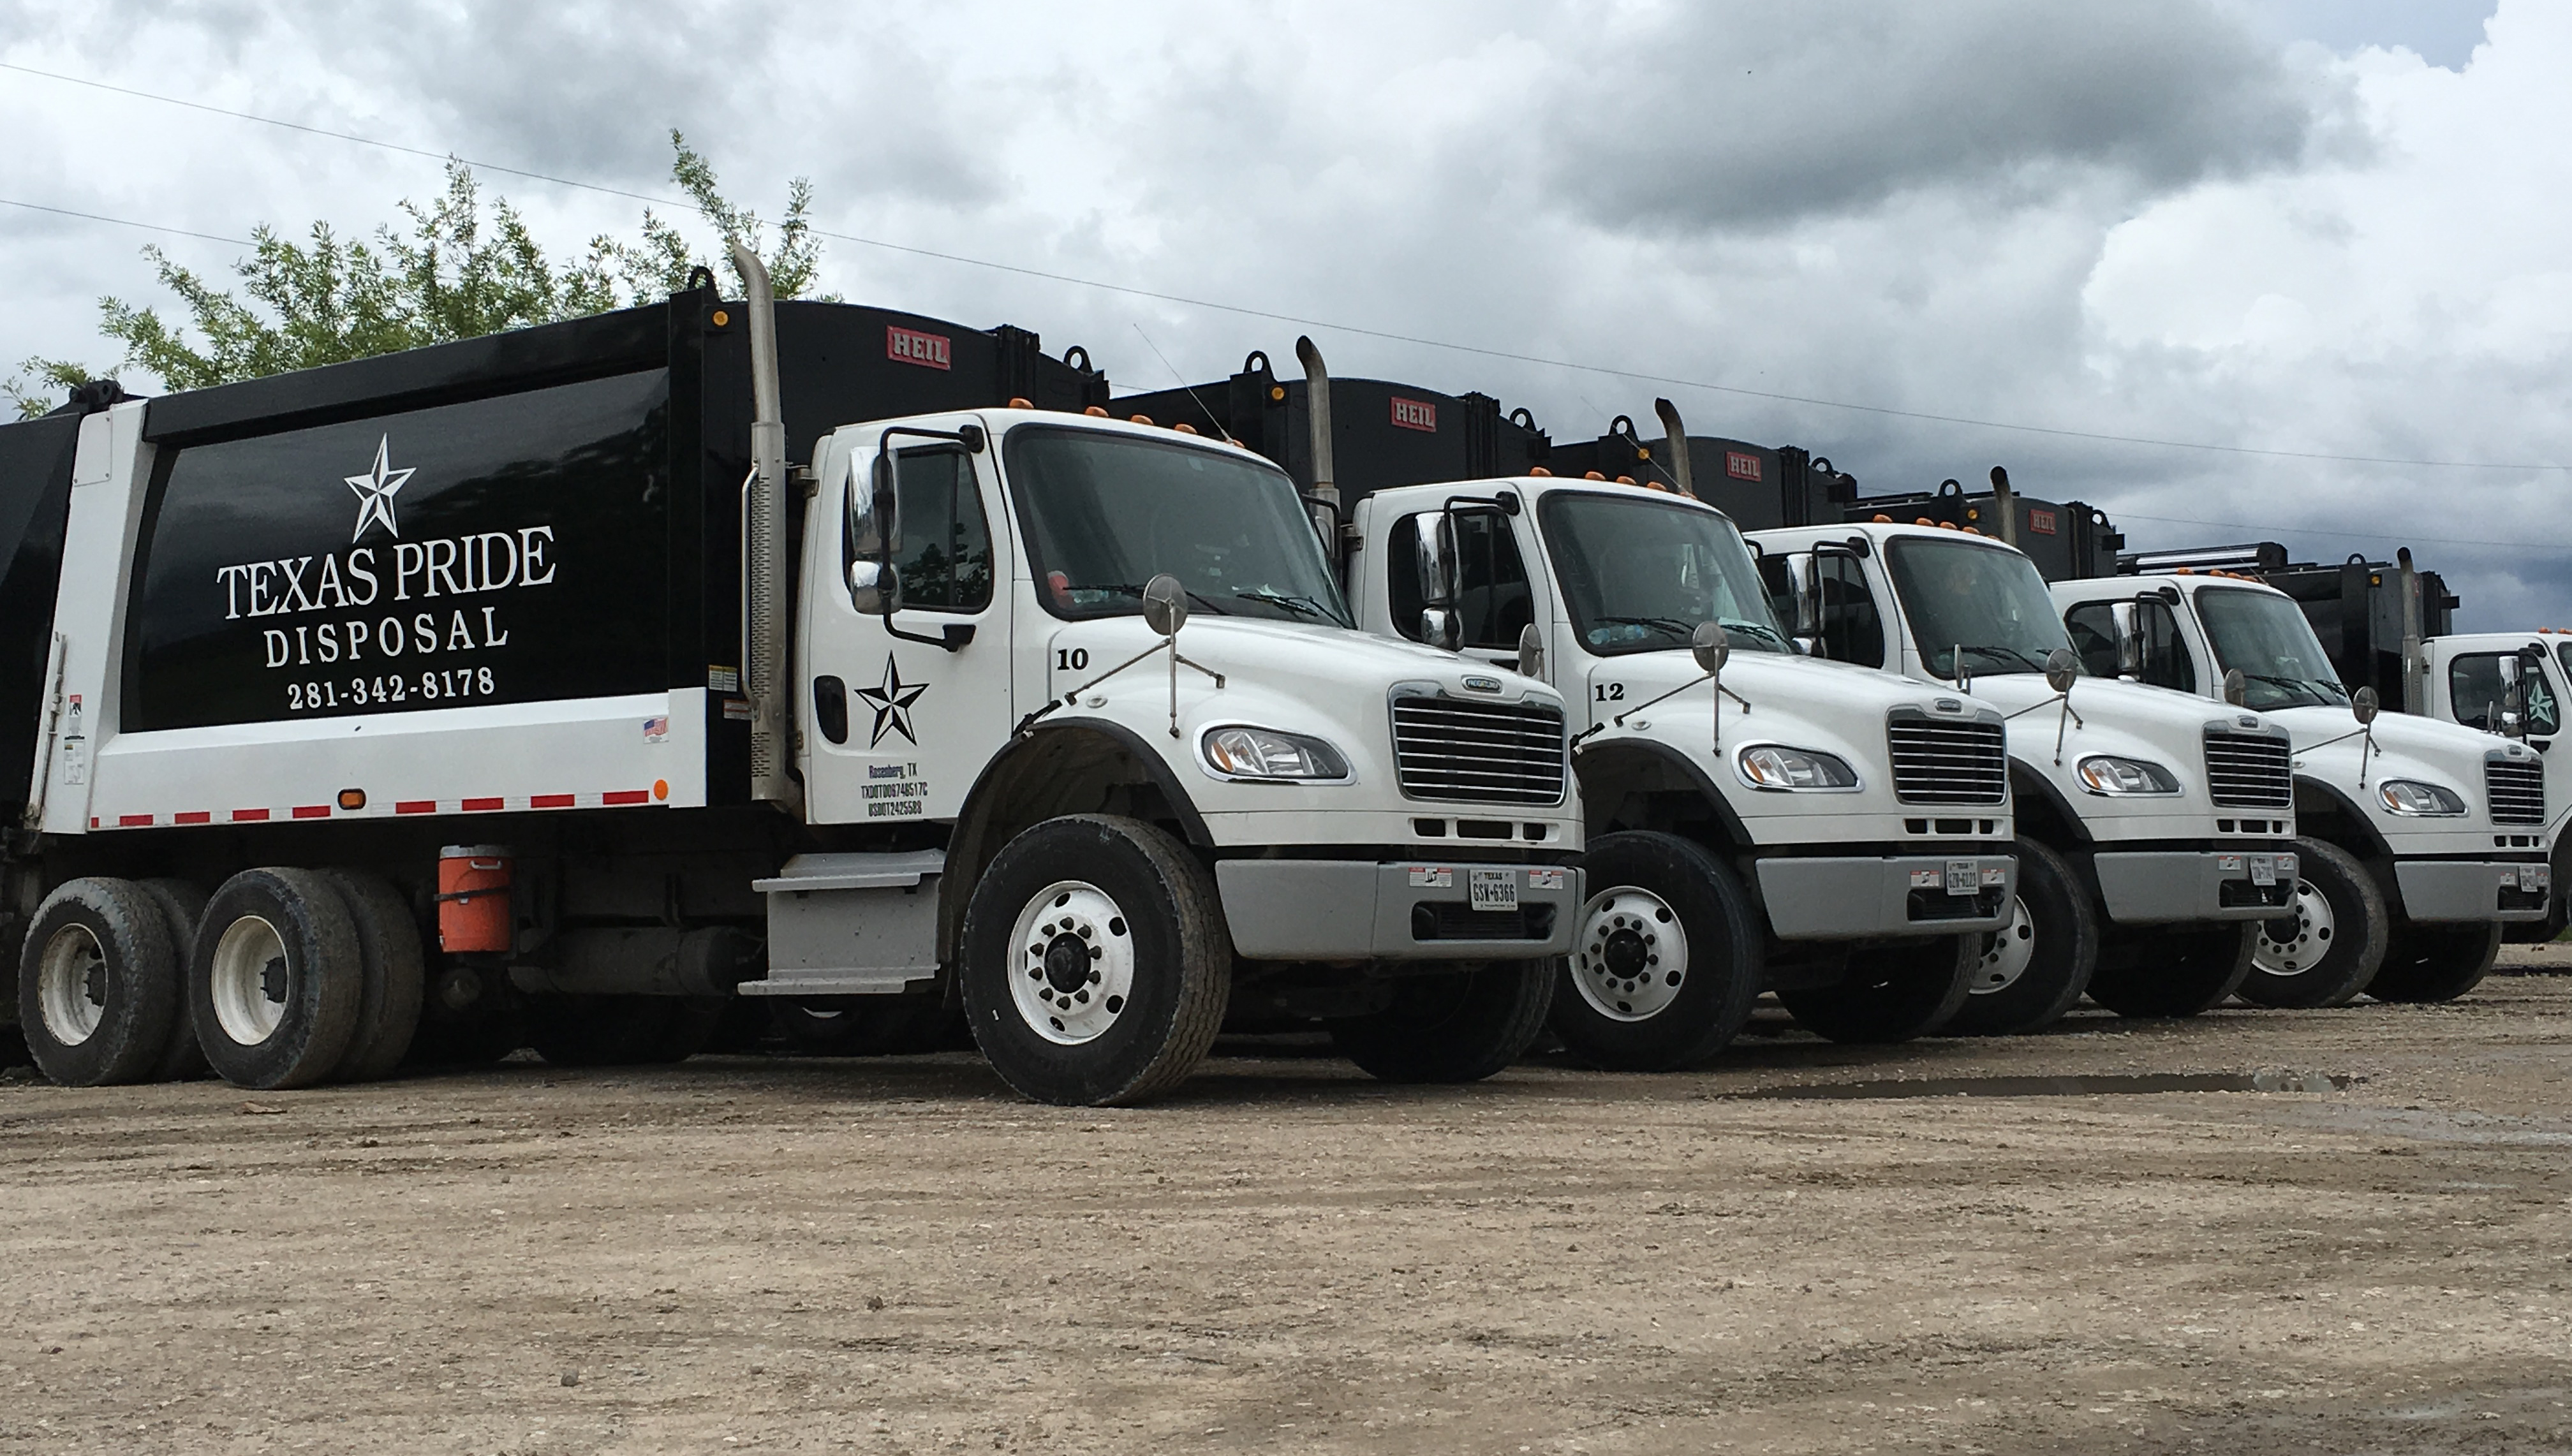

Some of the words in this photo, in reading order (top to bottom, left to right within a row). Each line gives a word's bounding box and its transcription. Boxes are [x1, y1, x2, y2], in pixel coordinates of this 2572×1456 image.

[893, 332, 948, 364] HEIL
[1396, 402, 1435, 427] HEIL
[1730, 456, 1760, 477] HEIL
[2033, 513, 2055, 531] HEIL
[217, 548, 378, 620] TEXAS
[393, 526, 556, 601] PRIDE
[263, 607, 508, 668] DISPOSAL
[1057, 648, 1088, 670] 10
[288, 667, 495, 710] 281-342-8178
[1595, 682, 1624, 702] 12
[907, 762, 917, 777] TX
[1484, 872, 1503, 880] TEXAS
